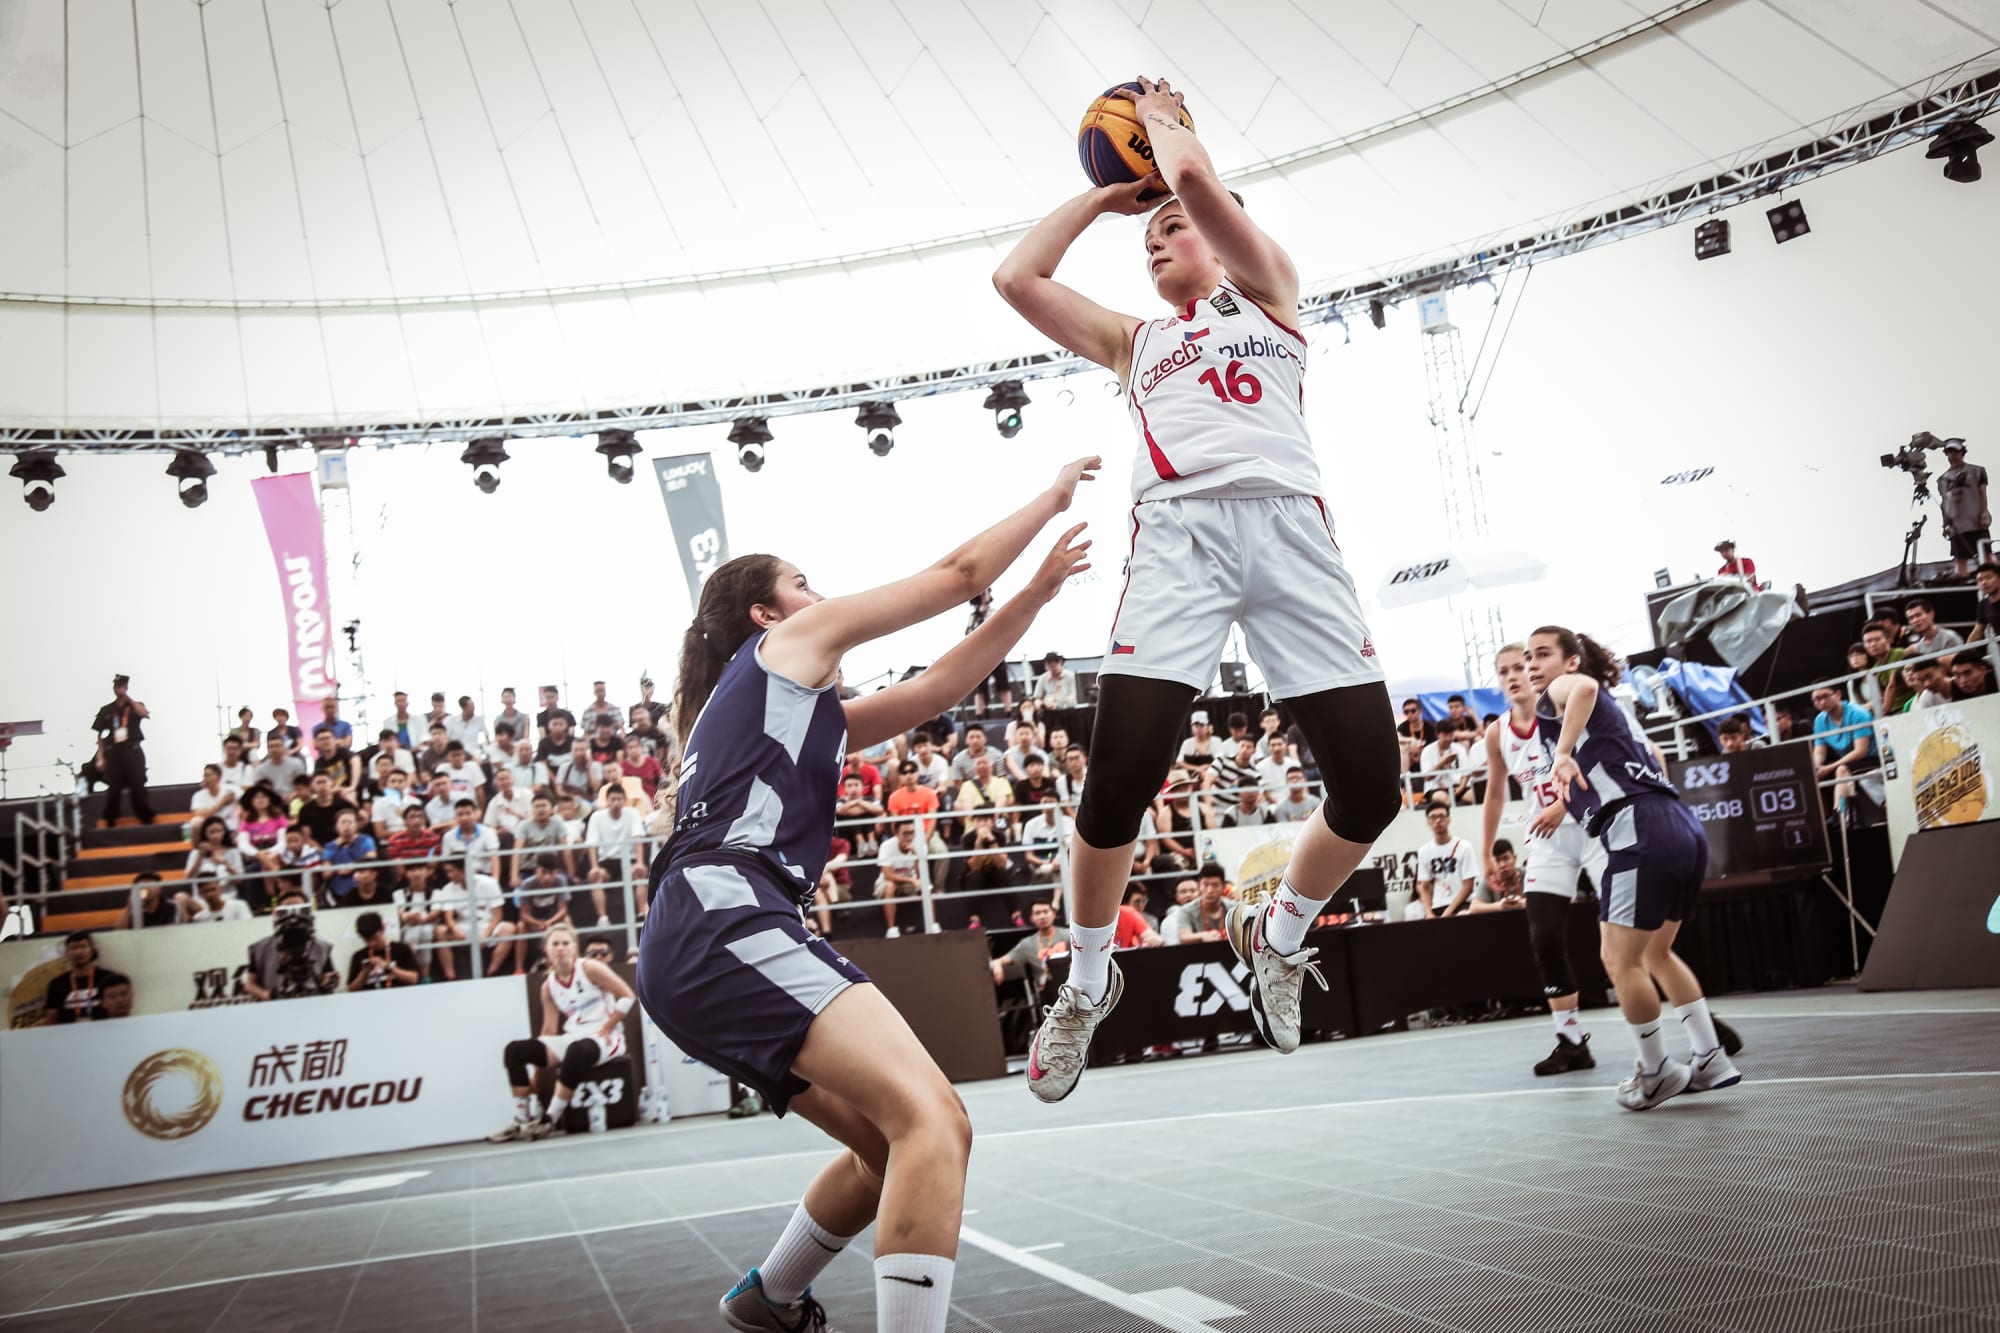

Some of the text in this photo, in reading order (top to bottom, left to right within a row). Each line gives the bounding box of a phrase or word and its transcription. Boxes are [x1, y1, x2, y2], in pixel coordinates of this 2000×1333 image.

[1198, 335, 1288, 359] public
[1198, 360, 1262, 404] 16
[1532, 781, 1559, 808] 15
[1760, 788, 1796, 813] 03
[1793, 830, 1803, 845] 1
[1174, 961, 1252, 1018] 3X
[248, 1038, 348, 1088] 成都
[243, 1077, 423, 1122] CHENGDU
